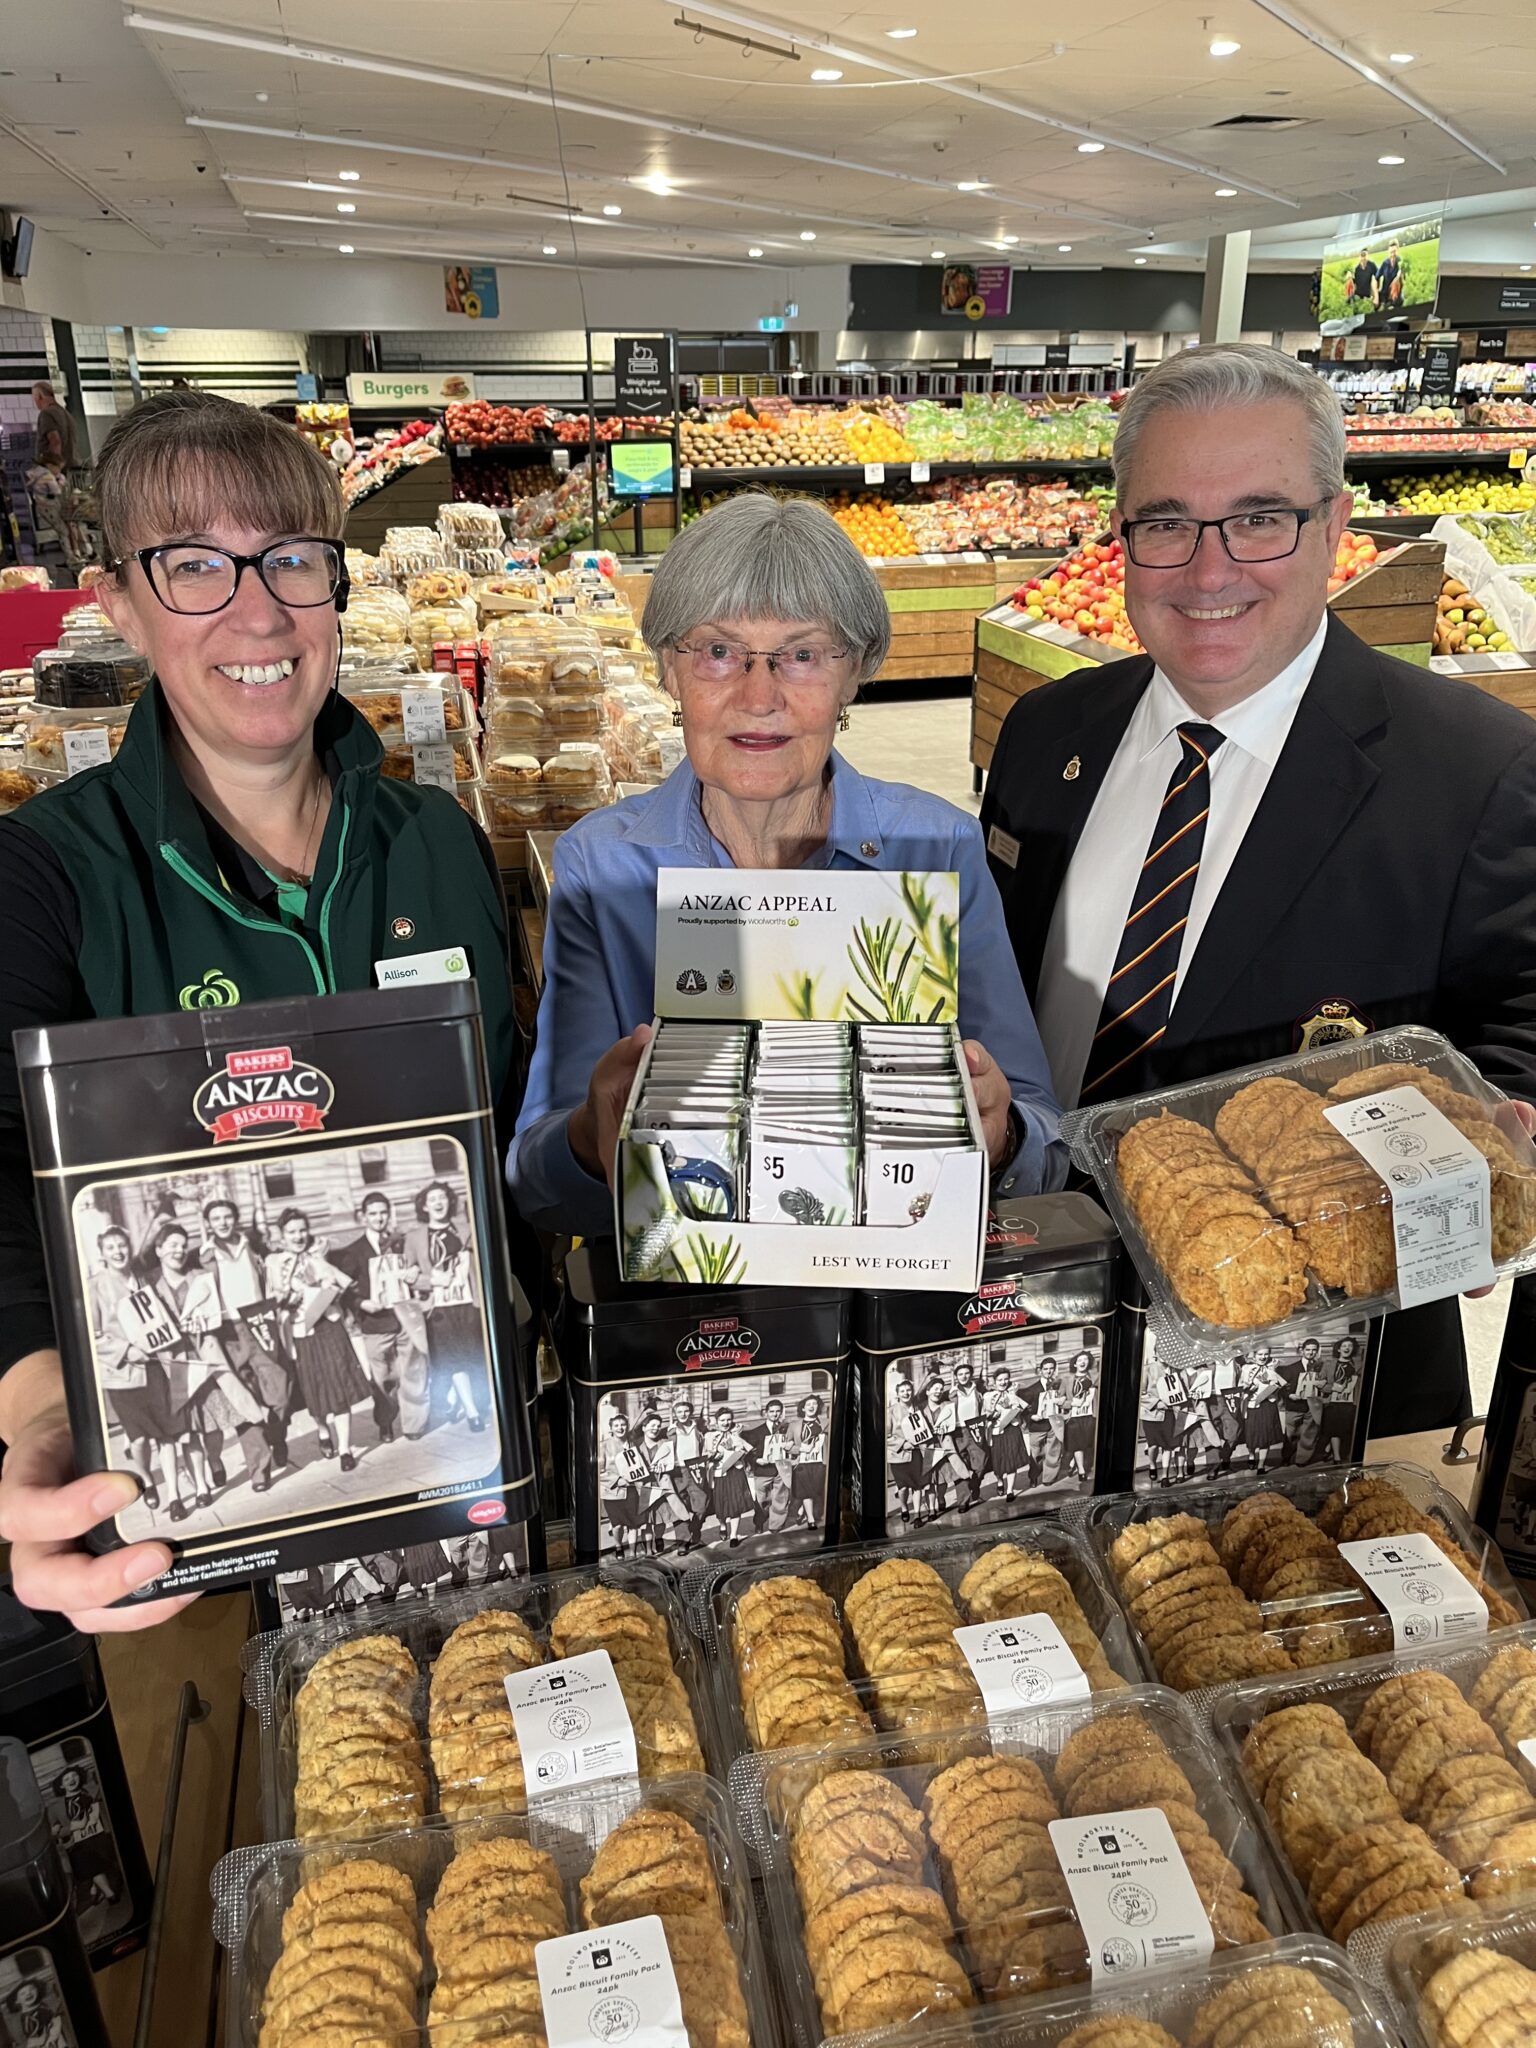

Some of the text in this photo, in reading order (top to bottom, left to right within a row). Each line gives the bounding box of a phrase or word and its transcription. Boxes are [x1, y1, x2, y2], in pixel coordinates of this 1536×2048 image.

[364, 380, 429, 399] Burgers
[626, 378, 646, 386] Weigh
[679, 895, 837, 912] ANZAC APPEAL
[678, 916, 786, 926] Proudly supported by Woolworths
[384, 968, 418, 981] Allison
[204, 1072, 319, 1108] ANZAC
[232, 1104, 304, 1126] BISCUITS
[1366, 1122, 1388, 1132] Biscuit
[1389, 1116, 1410, 1126] Family
[1411, 1111, 1426, 1119] Pack
[764, 1156, 785, 1180] $5
[882, 1163, 914, 1185] $10
[812, 1256, 951, 1270] LEST WE FORGET
[964, 1294, 1027, 1316] ANZAC
[978, 1312, 1018, 1325] BISCUITS
[146, 1322, 174, 1348] DAY
[683, 1332, 752, 1352] ANZAC
[699, 1350, 741, 1362] BISCUITS
[1169, 1392, 1183, 1403] DAY
[914, 1432, 930, 1443] DAY
[629, 1466, 646, 1479] DAY
[174, 1566, 189, 1577] has
[190, 1562, 211, 1573] been
[212, 1557, 243, 1569] helping
[244, 1549, 279, 1561] veterans
[1384, 1566, 1405, 1574] Biscuit
[162, 1558, 277, 1588] and their families since 1916
[976, 1644, 1059, 1664] Anzac Biscuit Family Pack
[1026, 1678, 1039, 1687] 50
[516, 1682, 607, 1709] Anzac Biscuit Family Pack
[555, 1698, 573, 1706] 24pk
[563, 1718, 576, 1728] 50
[1067, 1856, 1169, 1875] Anzac Biscuit Family Pack
[1111, 1870, 1132, 1879] 24pk
[1125, 1900, 1140, 1910] 50
[566, 1938, 641, 1977] WOOLWORTHS BAKERY
[551, 1963, 661, 1996] Anzac Biscuit Family Pack
[597, 1983, 619, 1994] 24pk
[606, 2013, 622, 2025] 50
